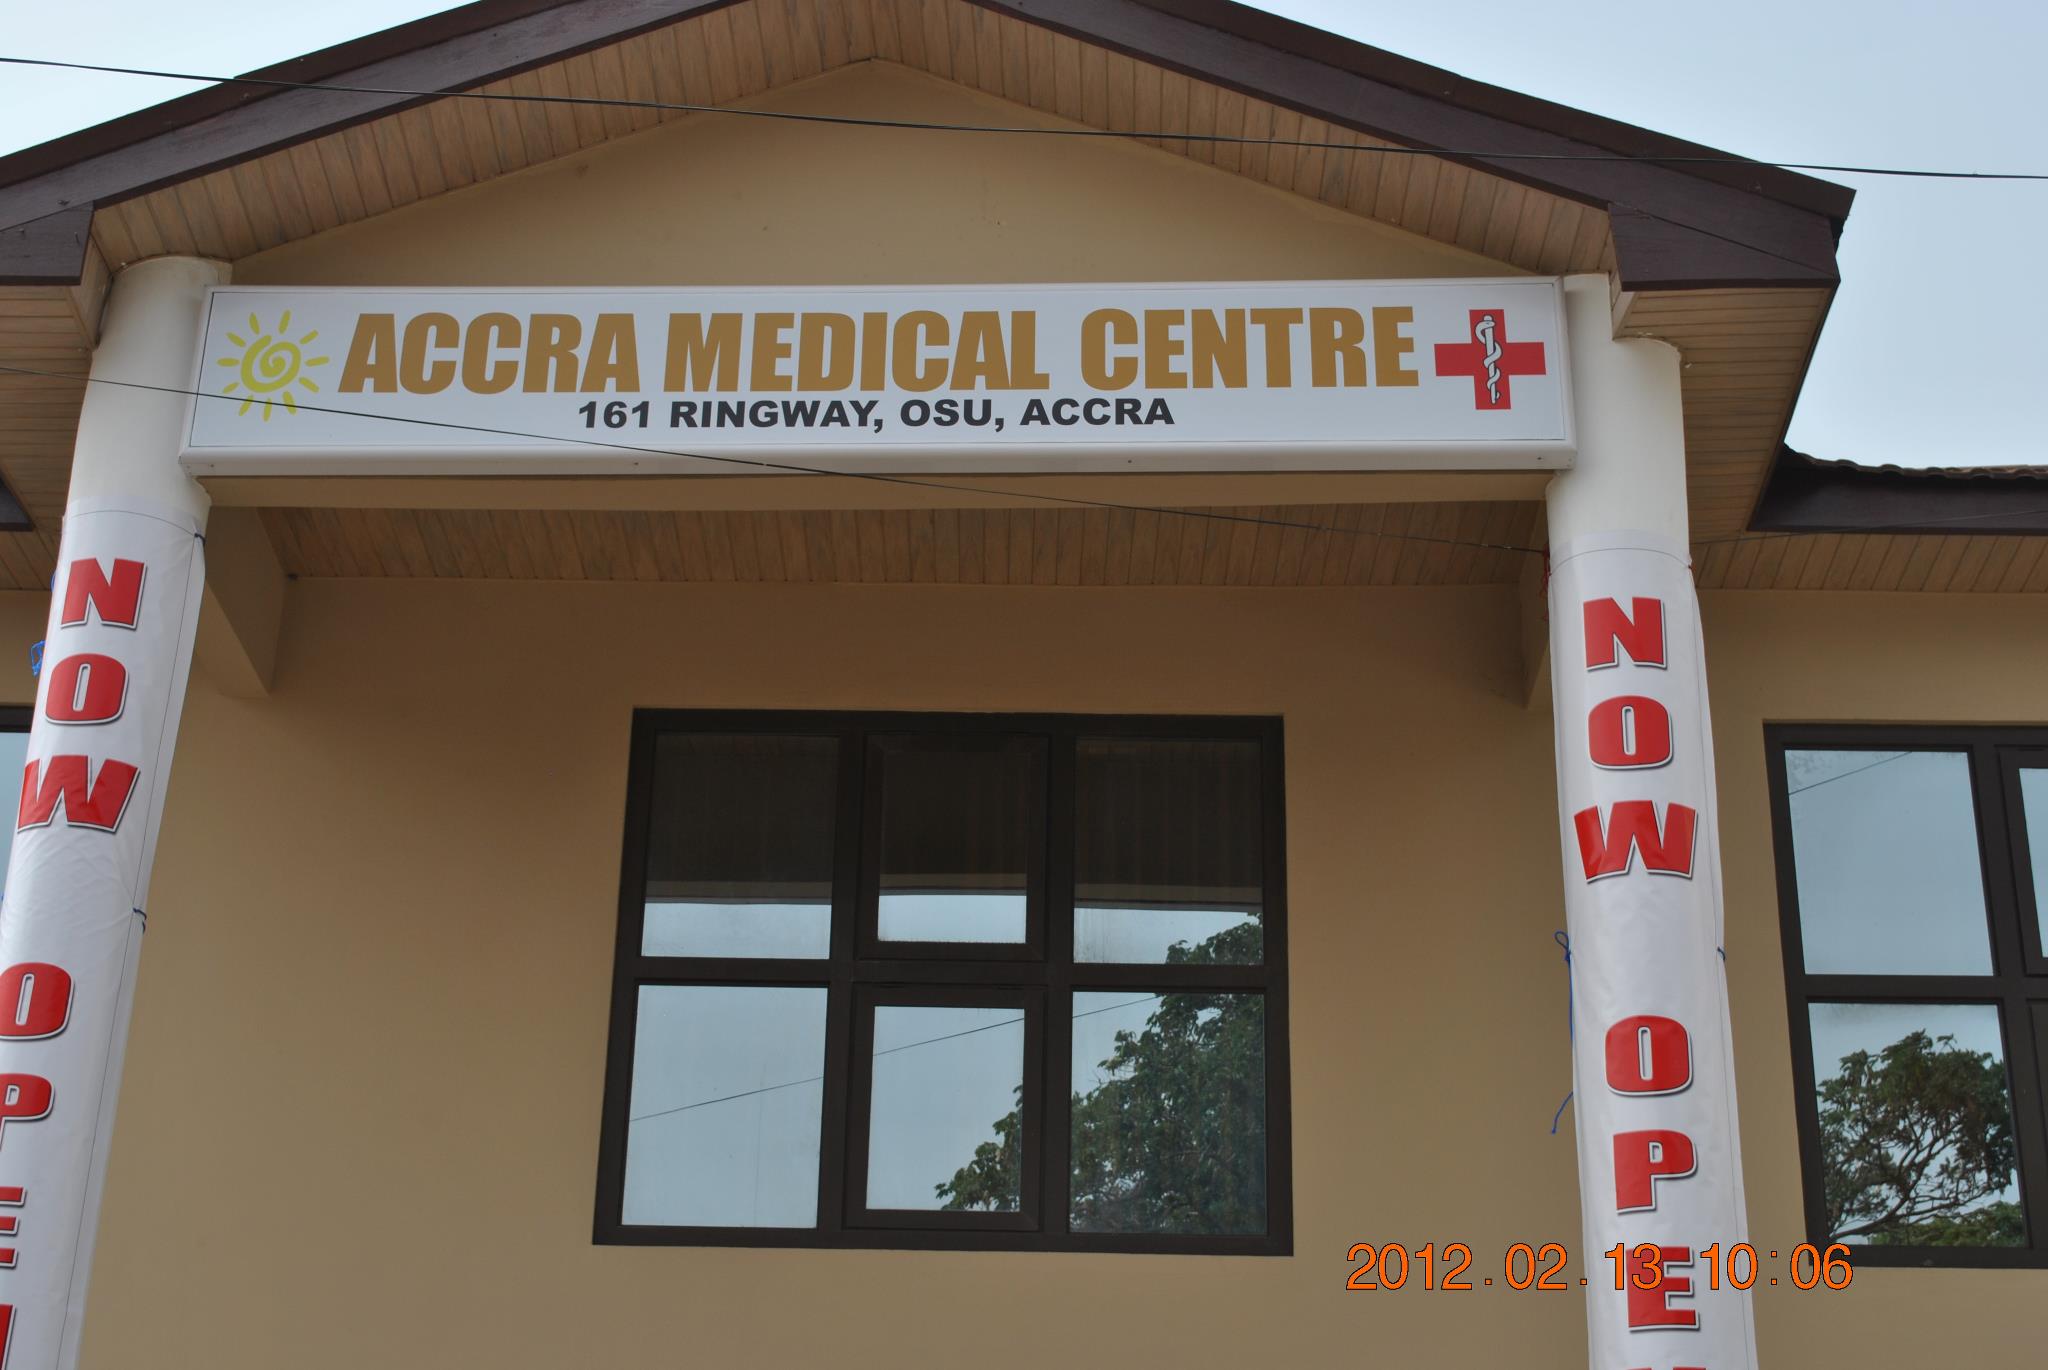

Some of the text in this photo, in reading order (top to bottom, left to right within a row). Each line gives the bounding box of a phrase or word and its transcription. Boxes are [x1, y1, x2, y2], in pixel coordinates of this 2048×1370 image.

[338, 306, 1419, 395] ACCRA MEDICAL CENTRE
[578, 397, 1176, 434] 161 RINGWAY, OSU, ACCRA
[17, 557, 146, 833] NOW
[1573, 596, 1706, 1370] NOW OPE
